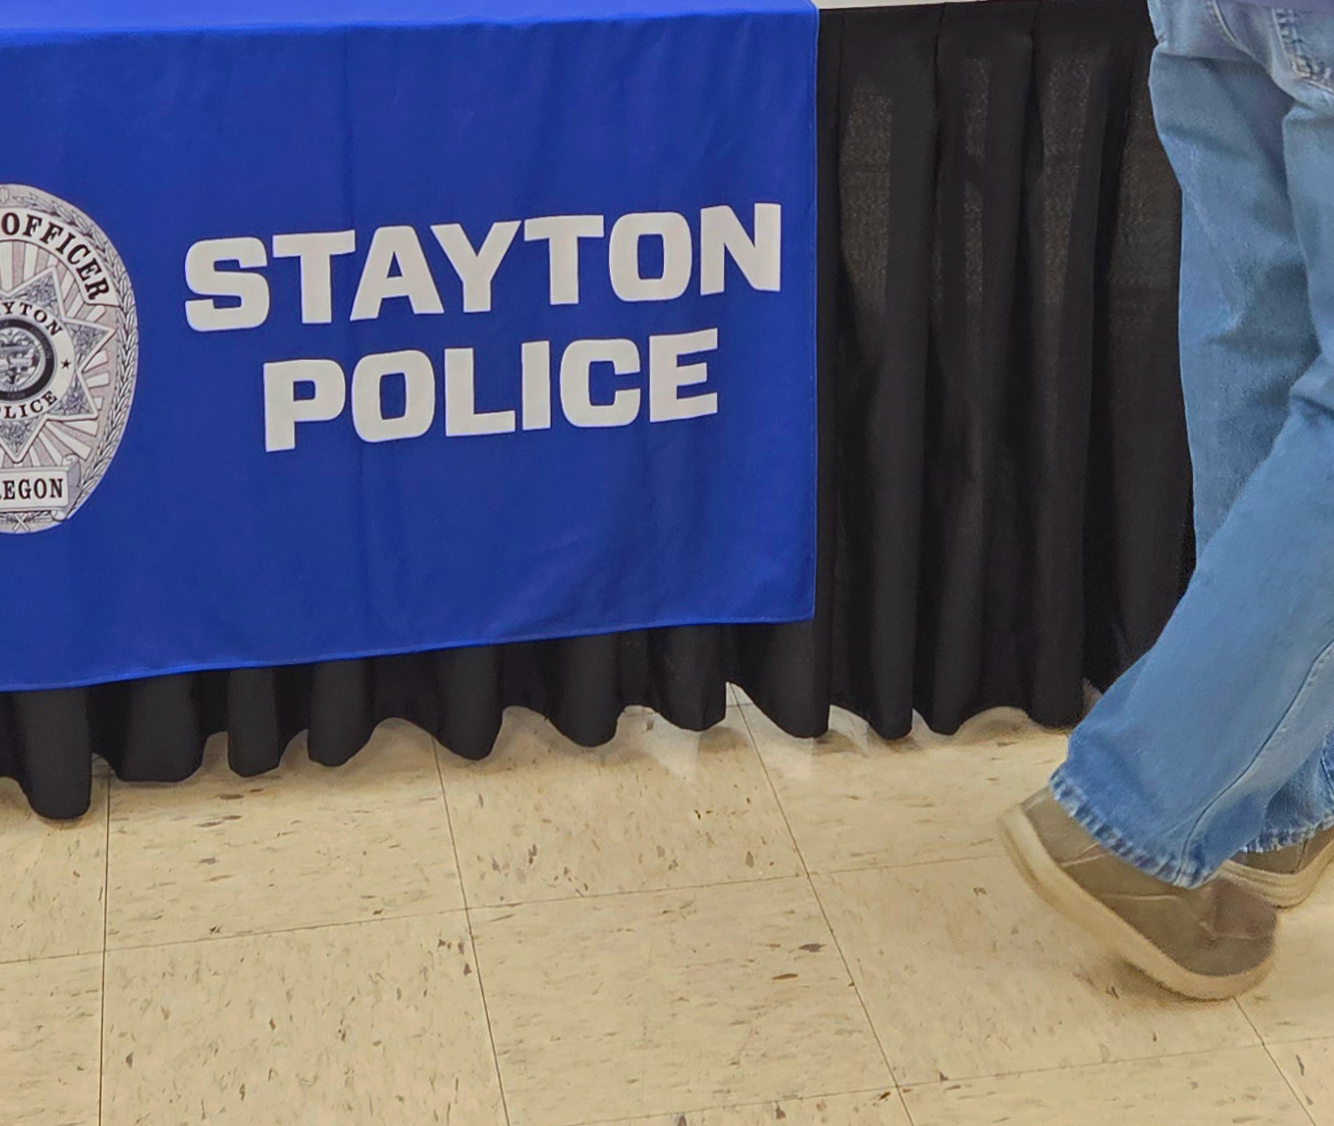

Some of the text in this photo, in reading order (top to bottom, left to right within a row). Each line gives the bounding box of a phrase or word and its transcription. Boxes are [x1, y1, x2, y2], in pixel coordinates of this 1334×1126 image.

[2, 212, 110, 301] OFFICER
[184, 203, 782, 332] STAYTON
[262, 327, 719, 452] POLICE
